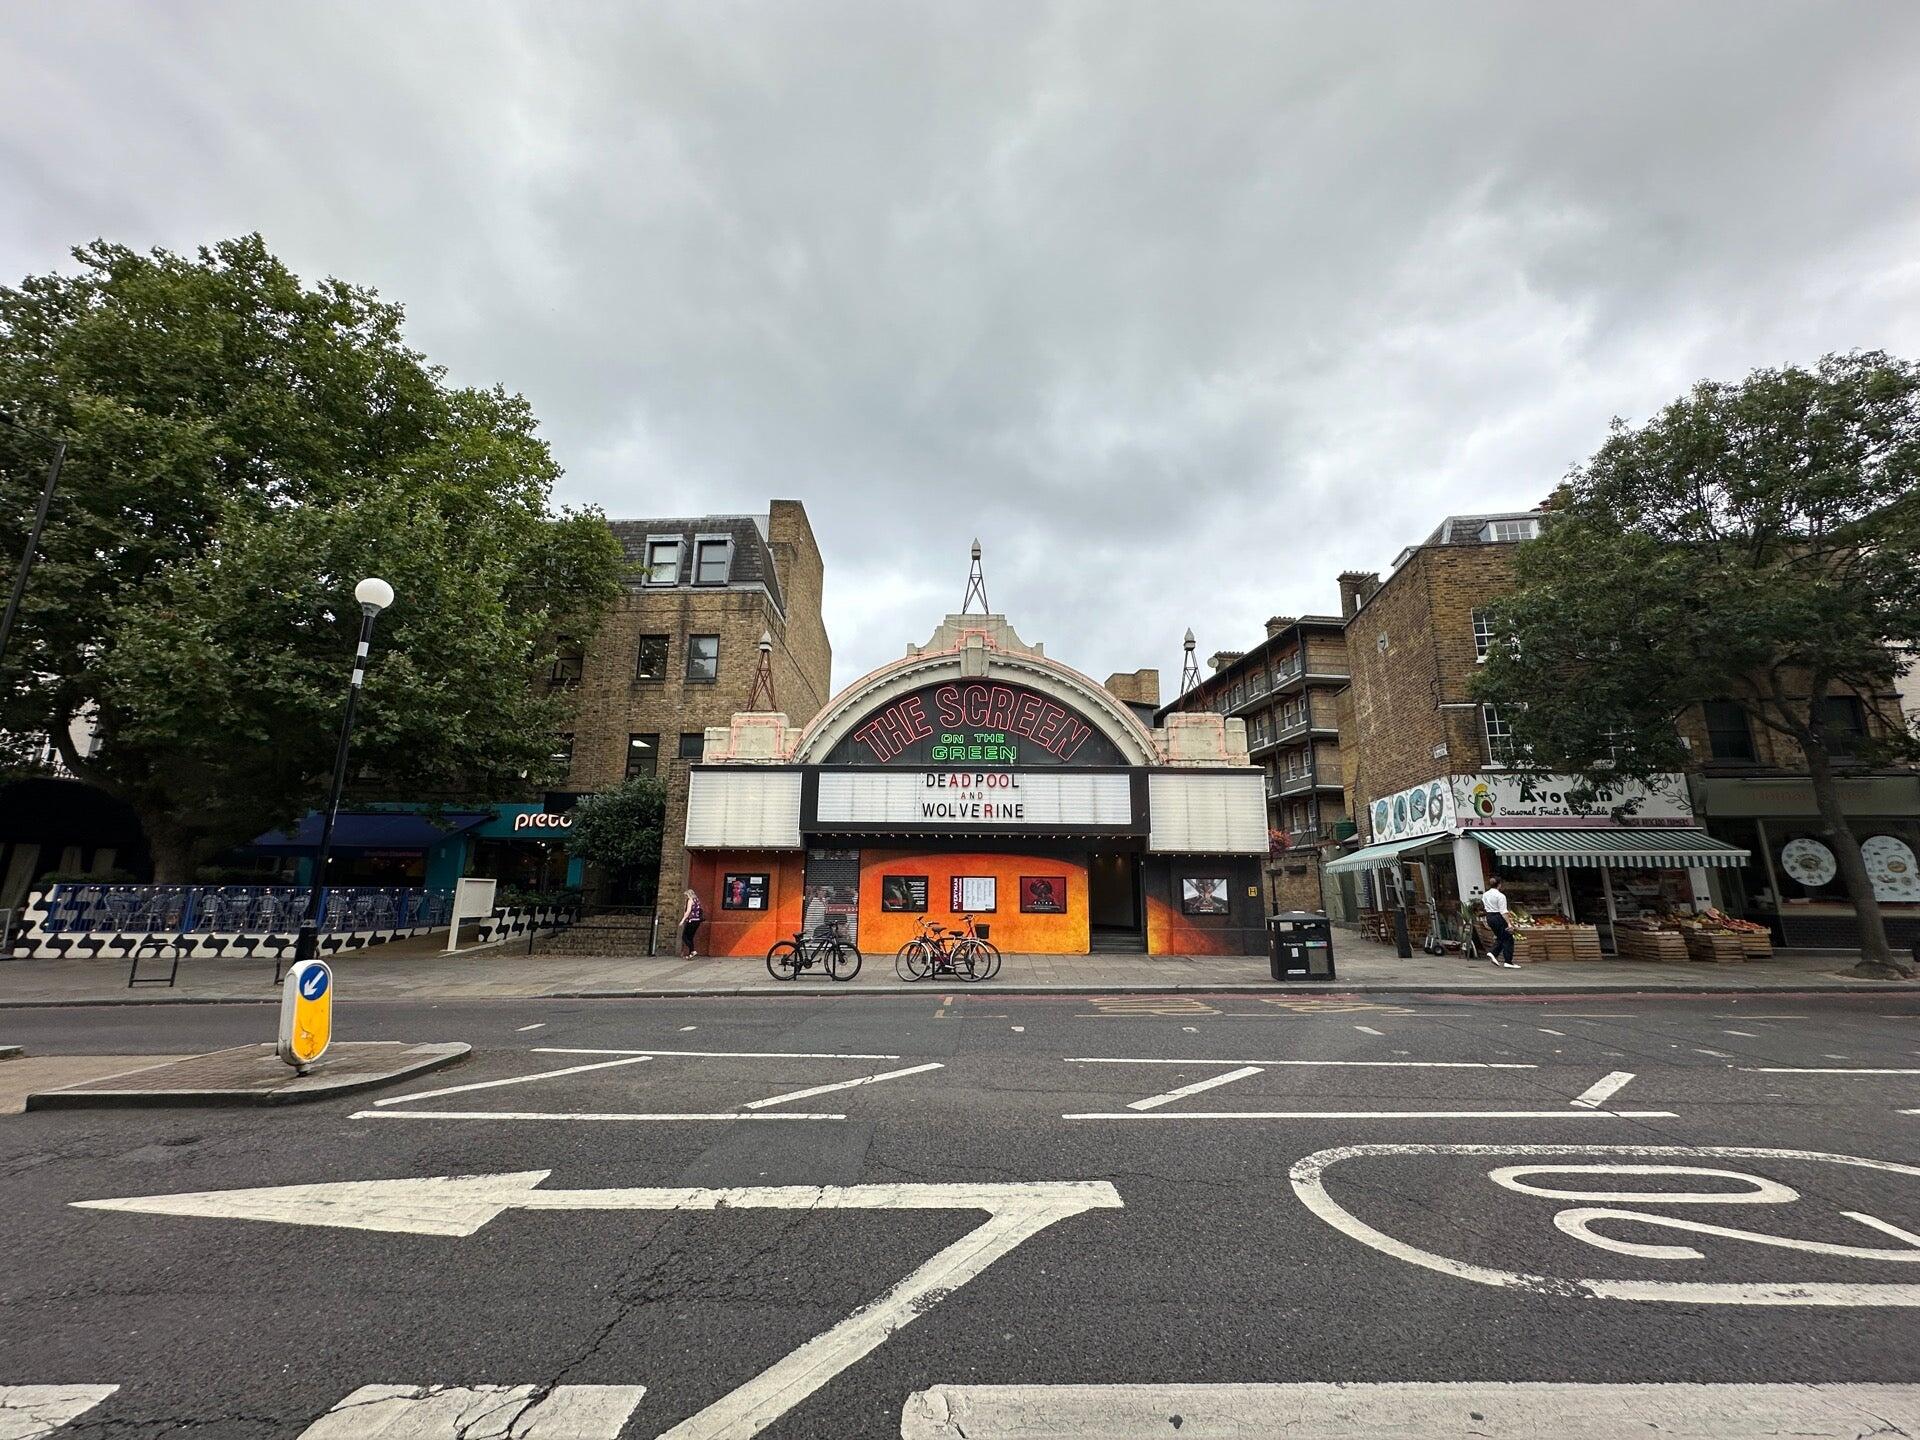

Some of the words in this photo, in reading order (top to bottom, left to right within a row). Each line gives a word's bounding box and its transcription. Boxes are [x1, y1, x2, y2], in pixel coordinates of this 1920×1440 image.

[853, 697, 933, 763] THE
[935, 685, 1092, 762] SCREEN
[940, 733, 964, 744] ON
[974, 733, 1005, 744] THE
[932, 746, 1017, 760] GREEN
[926, 773, 1020, 788] DEADPOOL
[960, 792, 984, 800] AND
[922, 803, 1024, 818] WOLVERINE
[1500, 806, 1536, 816] Seasonal
[1538, 807, 1561, 816] Fruit
[1563, 807, 1569, 816] &
